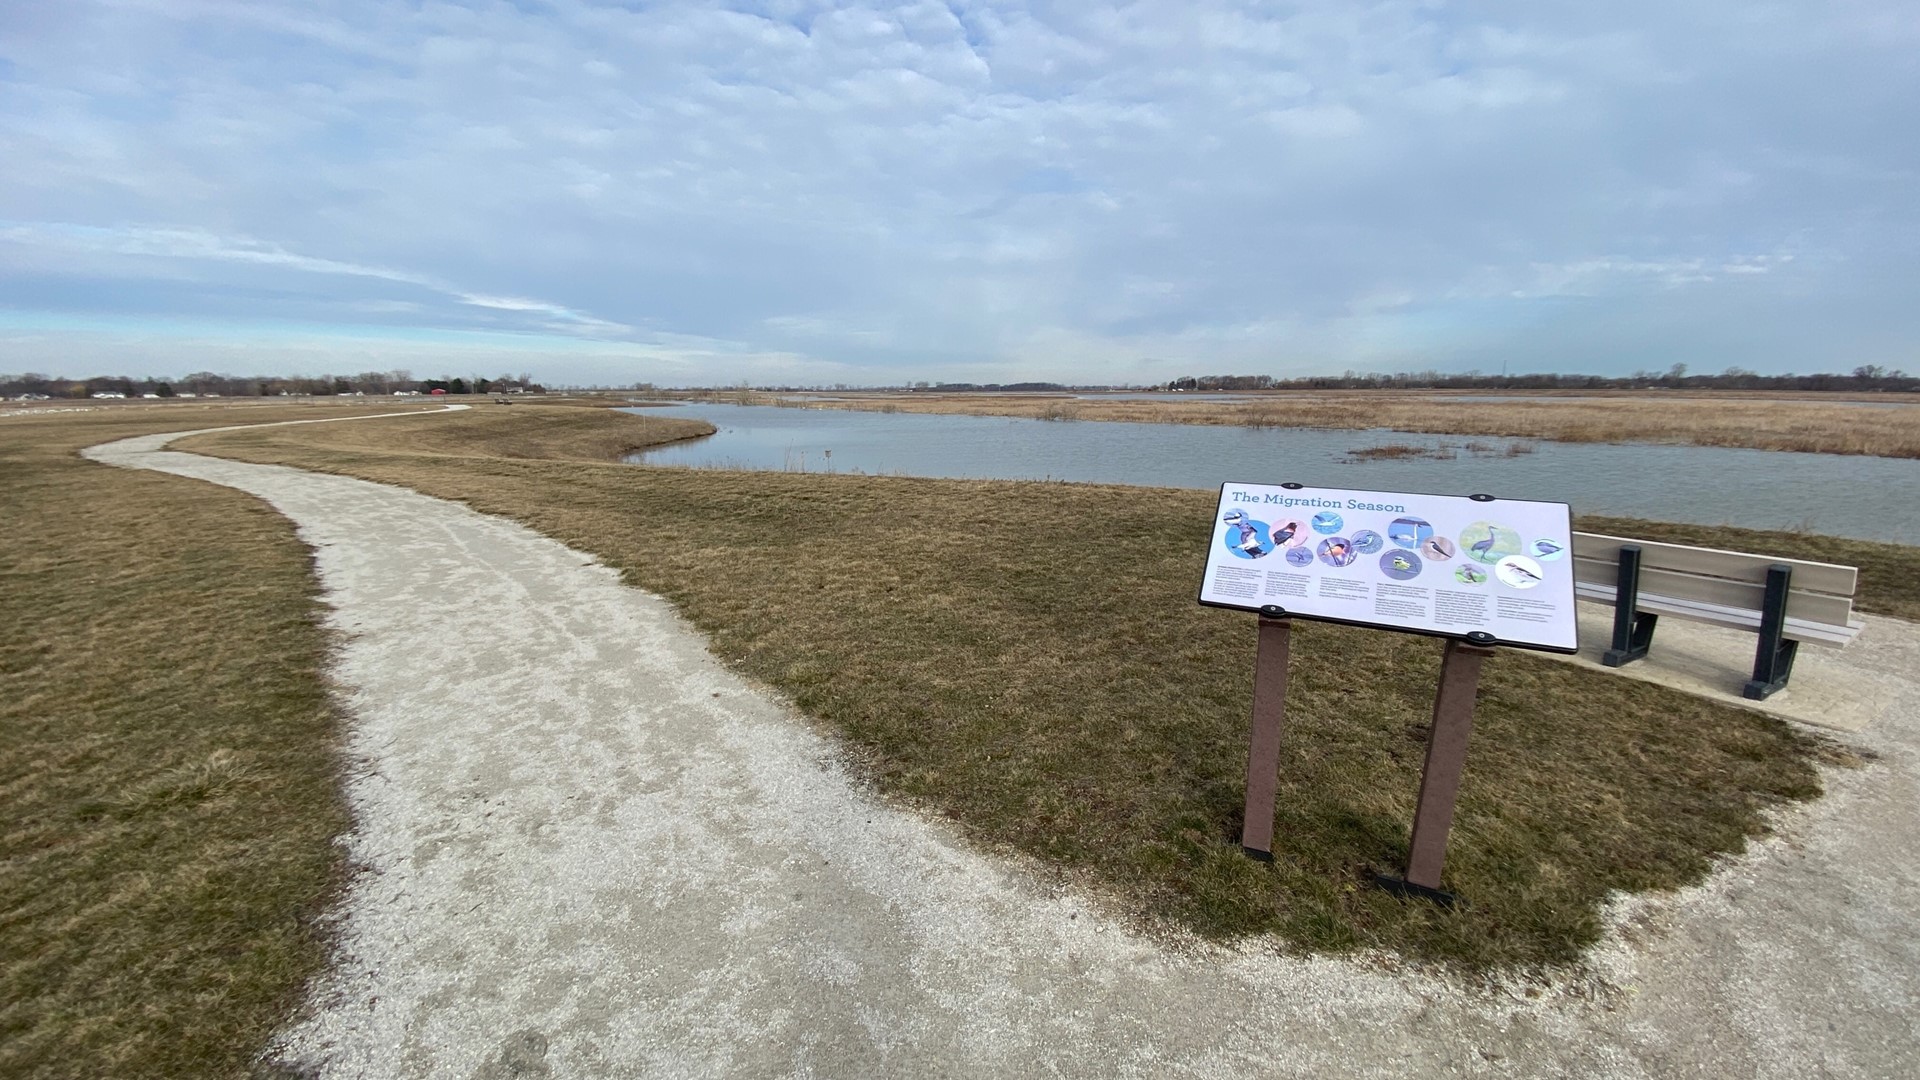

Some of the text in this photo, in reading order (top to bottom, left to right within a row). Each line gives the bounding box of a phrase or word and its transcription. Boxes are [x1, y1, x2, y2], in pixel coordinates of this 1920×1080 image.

[1232, 491, 1406, 513] The Migration Season
